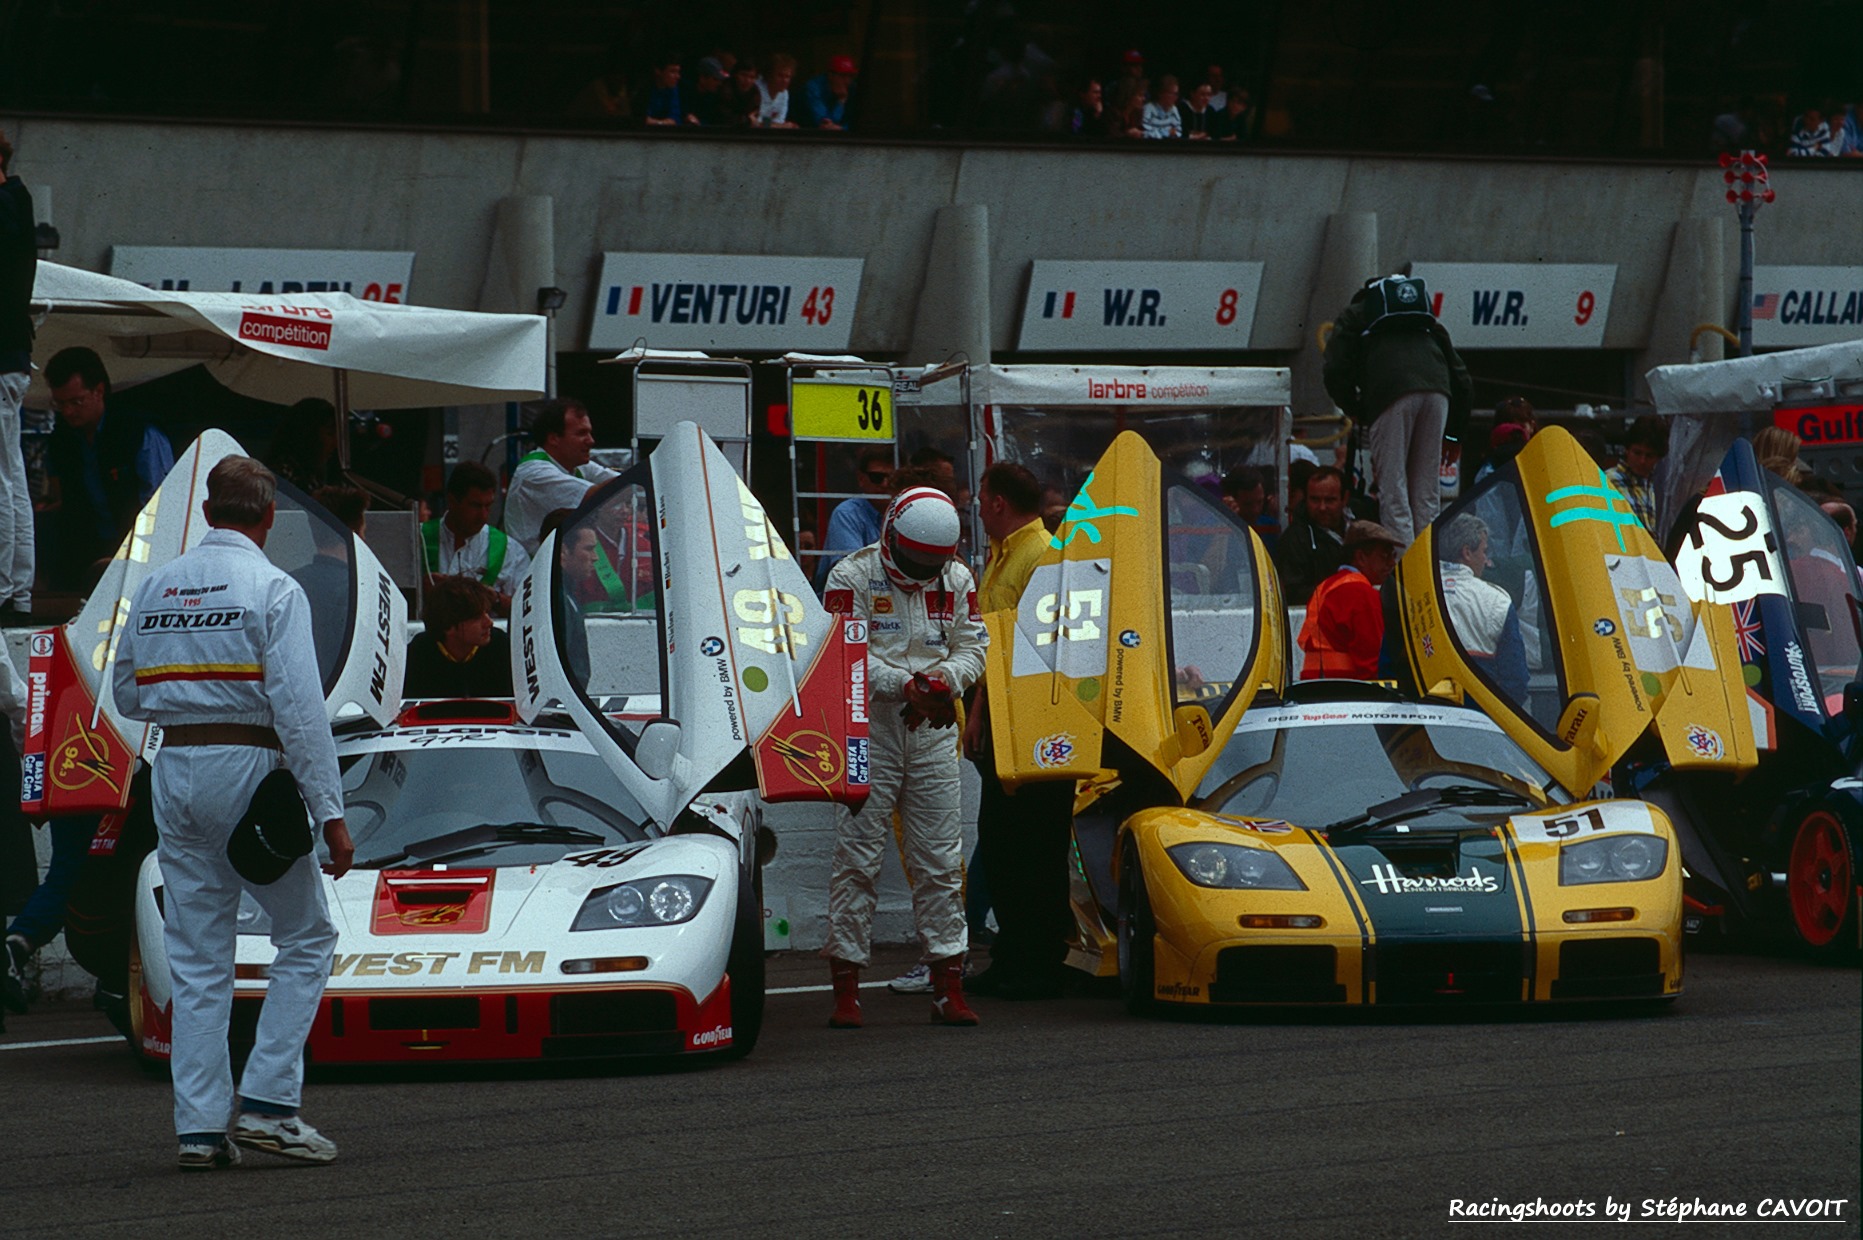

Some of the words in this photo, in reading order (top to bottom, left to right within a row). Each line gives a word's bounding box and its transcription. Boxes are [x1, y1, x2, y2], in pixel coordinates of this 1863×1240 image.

[652, 284, 791, 325] VENTURI
[802, 287, 834, 325] 43
[1103, 289, 1166, 327] W.R.
[1215, 289, 1238, 326] 8
[1472, 291, 1529, 326] W.R.
[1574, 291, 1595, 326] 9
[242, 320, 328, 345] compétition
[1088, 378, 1146, 398] larbre
[857, 389, 883, 431] 36
[1797, 410, 1863, 441] Gulf
[1690, 505, 1773, 592] 25
[162, 587, 178, 599] 24
[210, 584, 228, 593] MANS
[522, 575, 533, 618] FM
[141, 612, 240, 630] DUNLOP
[376, 572, 391, 655] WEST
[1036, 589, 1103, 646] 51
[1620, 587, 1685, 643] 51
[1612, 637, 1626, 659] BMW
[370, 652, 387, 705] FM
[522, 625, 540, 704] WEST
[719, 658, 731, 684] BMW
[1115, 648, 1125, 685] powered
[1622, 661, 1631, 673] by
[1785, 642, 1821, 716] AUTOSPORT
[29, 672, 51, 738] prima
[725, 686, 734, 698] by
[847, 658, 868, 723] prima
[1113, 688, 1123, 698] by
[1624, 674, 1645, 711] powered
[725, 699, 743, 741] powered
[1113, 700, 1123, 723] BMW
[1352, 713, 1444, 721] MOTORSPORT
[147, 722, 160, 751] BMW
[410, 734, 497, 747] GTR
[857, 739, 868, 763] Care
[24, 755, 35, 774] Car
[34, 760, 44, 792] BASTA
[848, 746, 858, 777] BASTA
[857, 763, 868, 784] Car
[22, 774, 34, 800] Care
[1542, 807, 1608, 839] 51
[563, 844, 653, 867] 49
[1361, 864, 1498, 894] Harrods
[467, 951, 547, 974] FM
